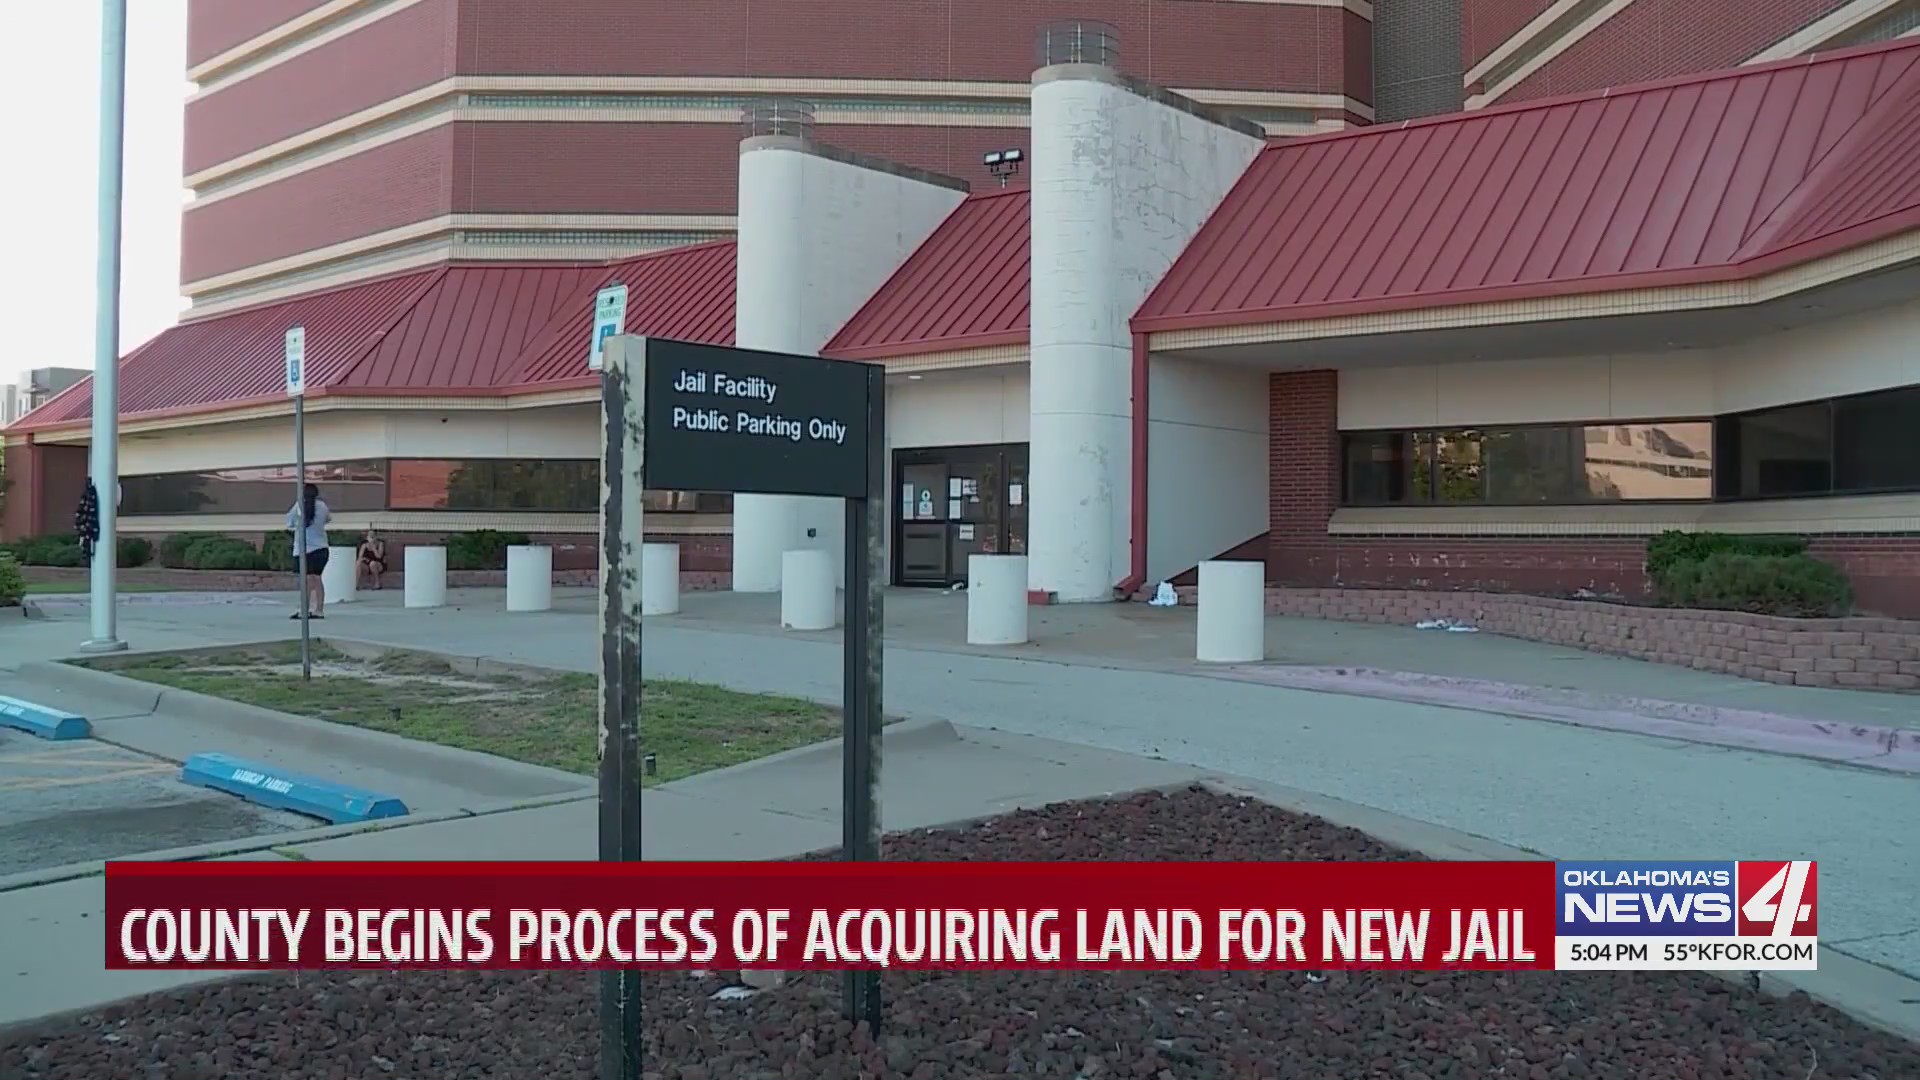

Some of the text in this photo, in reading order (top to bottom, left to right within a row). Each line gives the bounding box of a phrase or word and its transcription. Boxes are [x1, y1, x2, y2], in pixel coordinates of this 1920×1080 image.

[673, 370, 777, 403] Jail Facility
[673, 407, 846, 444] Public Parking Only
